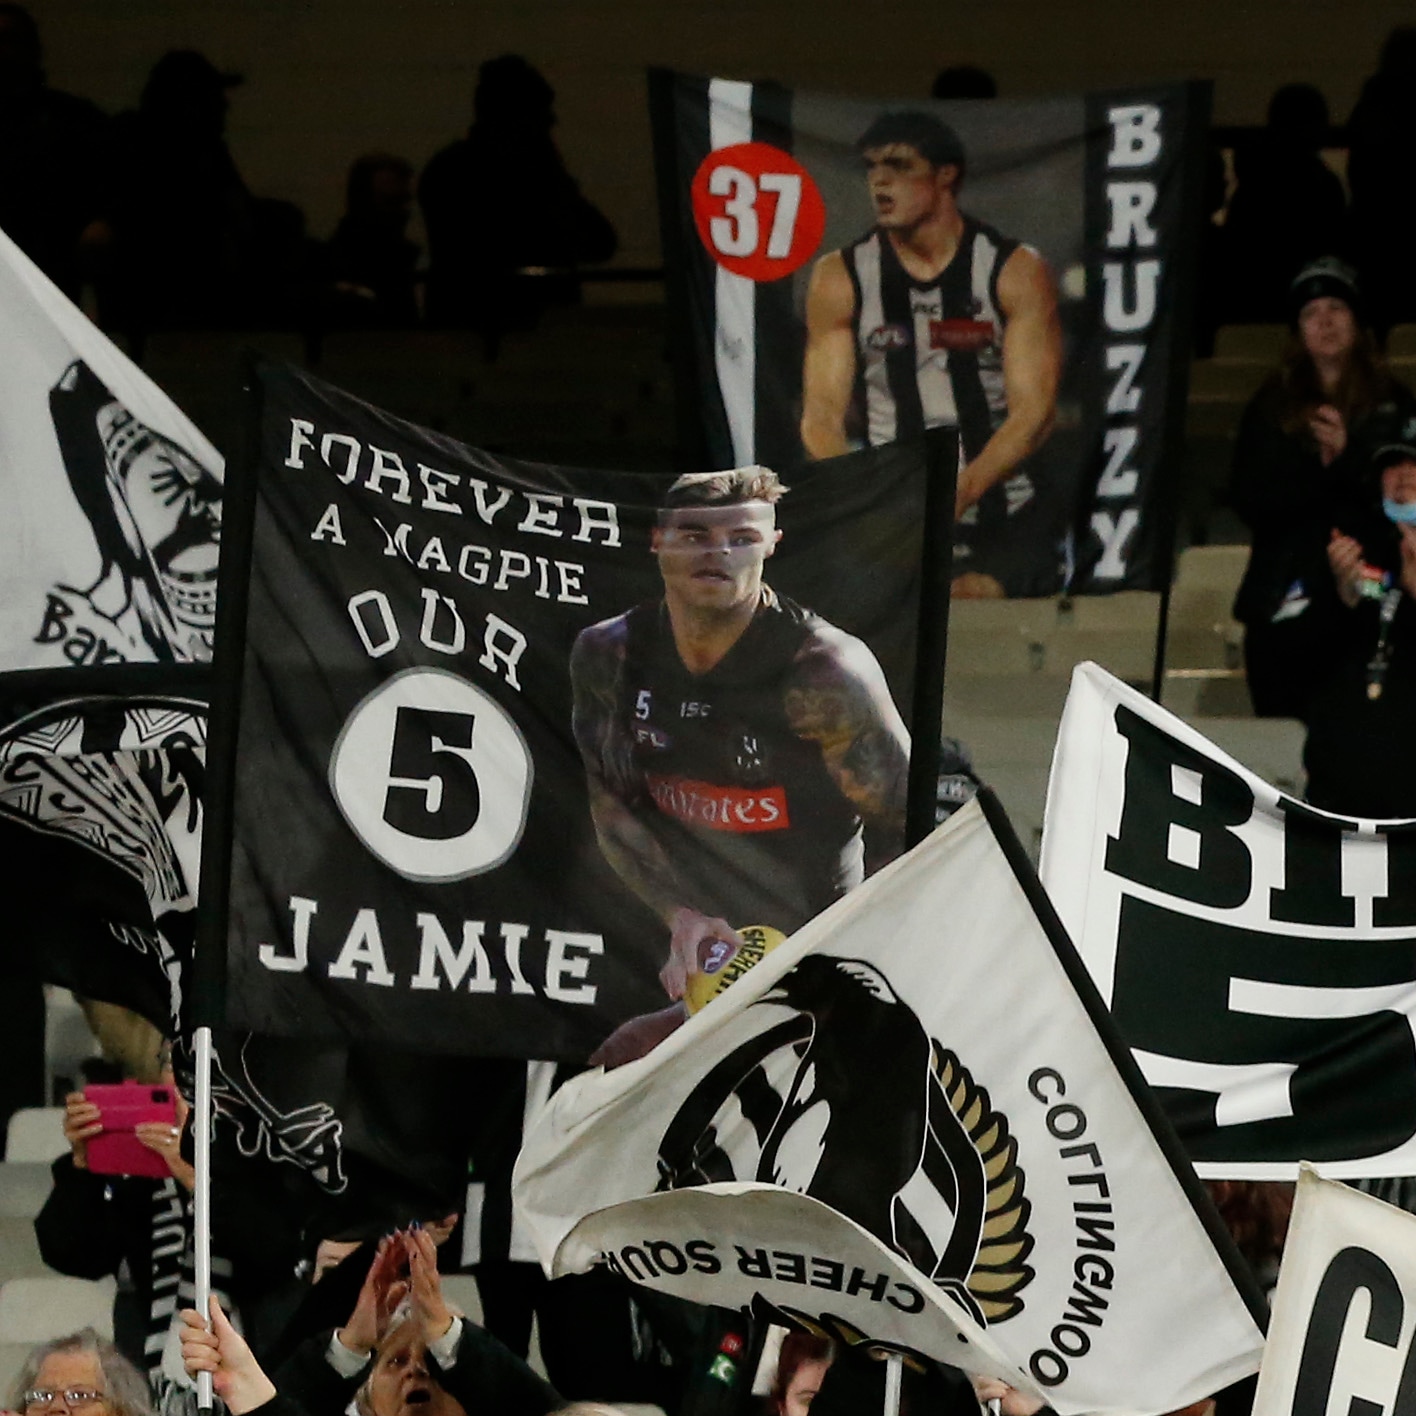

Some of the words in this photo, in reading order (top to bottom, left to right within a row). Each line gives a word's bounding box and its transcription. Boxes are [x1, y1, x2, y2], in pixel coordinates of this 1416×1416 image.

[709, 166, 800, 259] 37
[1091, 104, 1161, 580] BRUZZY
[285, 418, 622, 547] FOREVER
[310, 503, 347, 546] A
[373, 516, 589, 605] MAGPIE
[348, 588, 528, 691] OUR
[634, 690, 651, 720] 5
[382, 705, 480, 841] 5
[258, 896, 605, 1005] JAMIE
[734, 1244, 926, 1314] CHEER
[1020, 1065, 1117, 1389] COLLINGWOO
